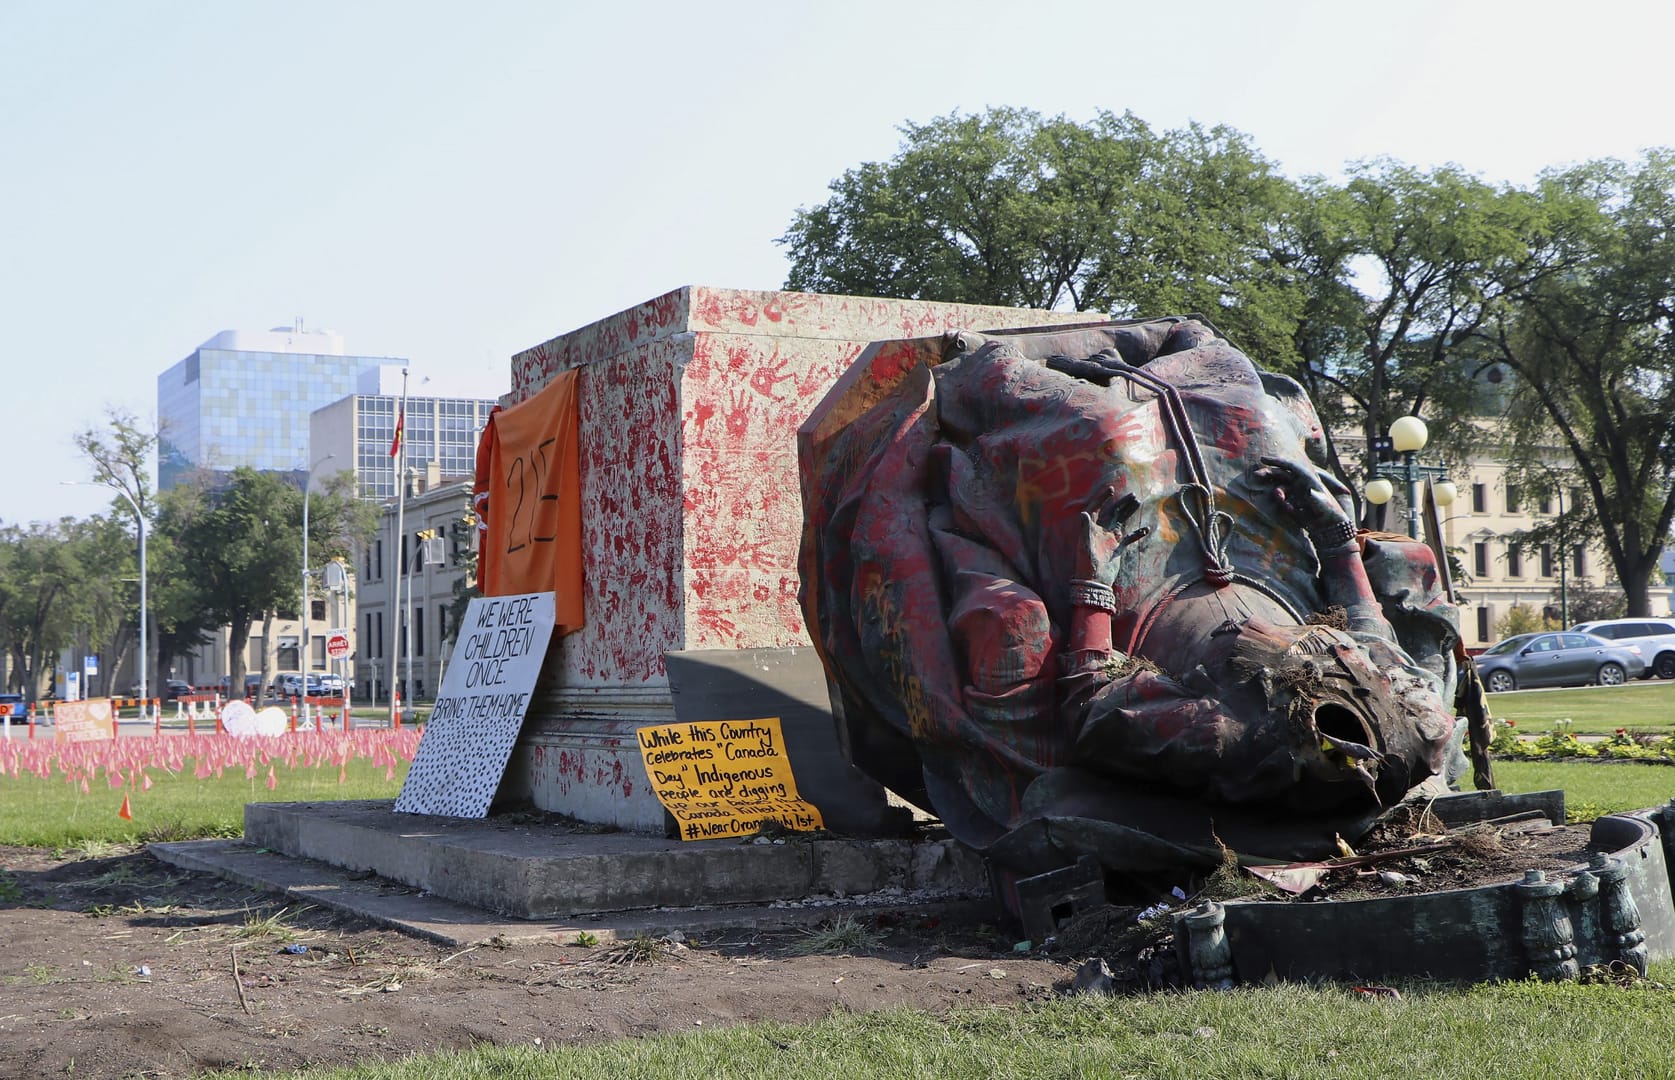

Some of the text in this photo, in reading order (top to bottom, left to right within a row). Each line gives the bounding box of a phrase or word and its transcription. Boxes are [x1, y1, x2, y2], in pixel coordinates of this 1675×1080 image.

[477, 596, 539, 628] WE WERE
[464, 626, 536, 660] CHILDREN
[465, 658, 510, 688] ONCE.
[431, 692, 528, 721] BRING THEM HOME
[639, 722, 772, 749] While this Country
[694, 763, 773, 790] Indigenous
[709, 788, 735, 799] are
[739, 783, 786, 800] digging
[666, 802, 688, 811] up
[677, 808, 736, 821] Canada
[731, 816, 768, 834] Oran
[796, 813, 815, 828] 1st
